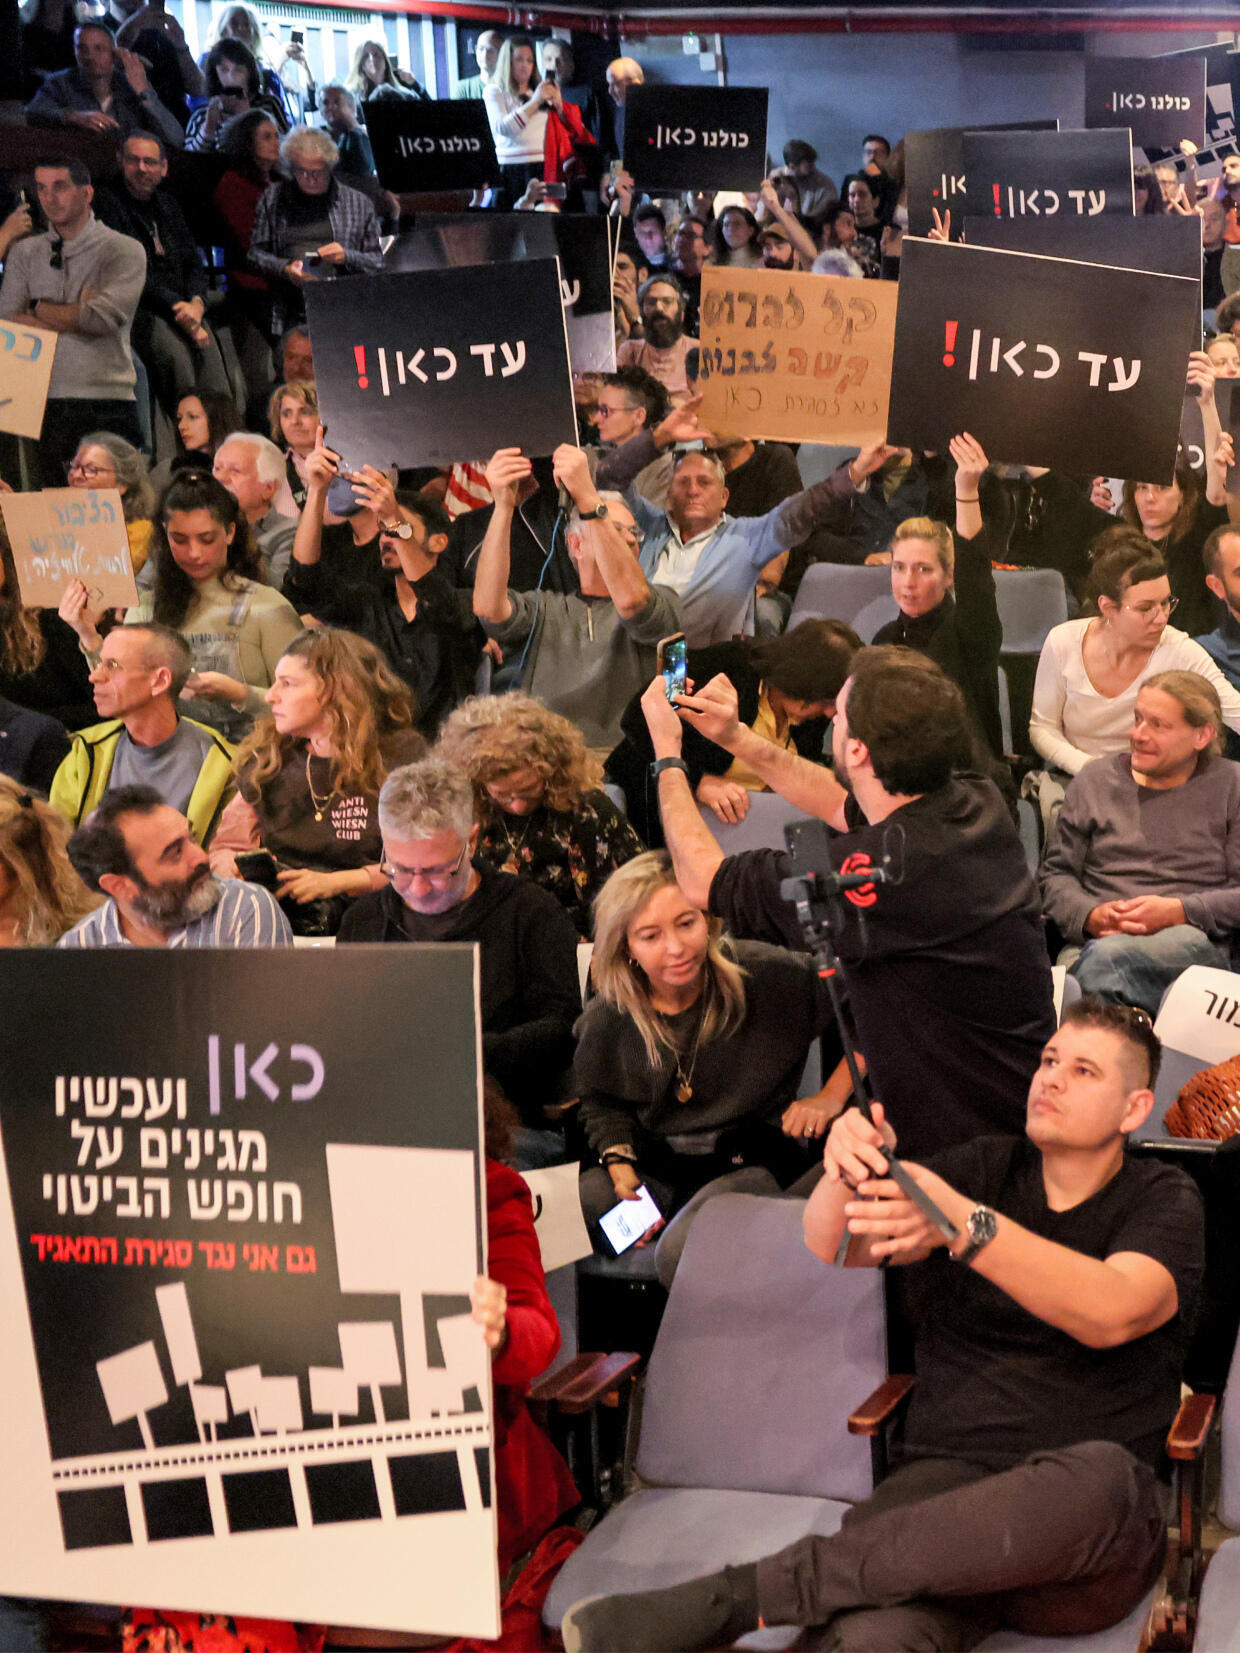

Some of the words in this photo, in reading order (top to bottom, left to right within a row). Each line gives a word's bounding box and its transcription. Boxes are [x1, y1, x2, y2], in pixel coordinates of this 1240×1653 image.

[1105, 91, 1146, 112] כאן.
[1150, 94, 1191, 111] כולנו
[440, 136, 482, 153] כולנו
[648, 124, 696, 150] כאן.
[701, 129, 749, 149] כולנו
[933, 173, 967, 201] אן.
[992, 183, 1060, 218] כאן!
[1068, 189, 1106, 217] עד
[469, 340, 526, 378] עד
[942, 320, 1061, 381] כאן!
[353, 345, 458, 397] כאן!
[1077, 351, 1142, 392] עד
[331, 807, 369, 819] WIESN
[338, 796, 364, 809] ANTI
[331, 818, 367, 830] WIESN
[336, 829, 361, 841] CLUB
[208, 1034, 325, 1116] כאן
[54, 1076, 187, 1121] ועכשיו
[70, 1118, 123, 1170] על
[140, 1128, 267, 1172] מגינים
[43, 1173, 170, 1218] הביטוי
[187, 1178, 302, 1224] חופש
[30, 1233, 119, 1265] התאגיד
[124, 1237, 193, 1268] סגירת
[198, 1241, 236, 1270] נגד
[243, 1243, 279, 1272] אני
[286, 1244, 317, 1273] גם
